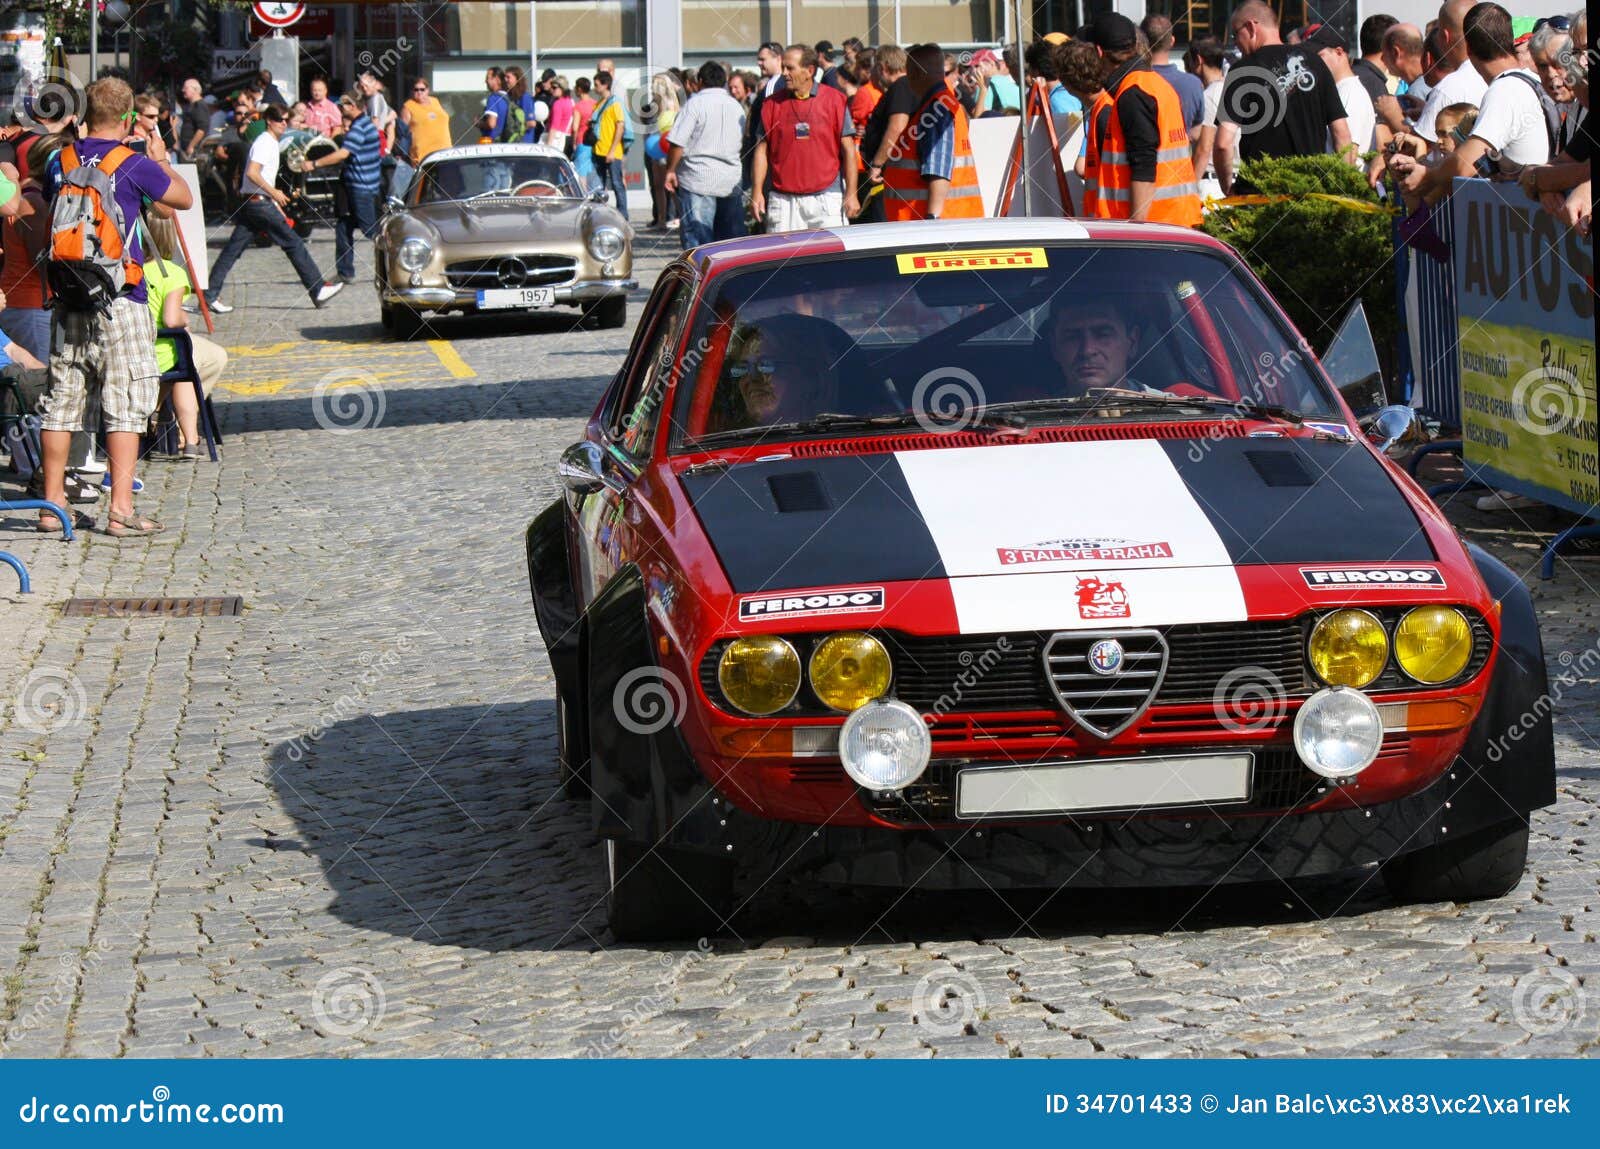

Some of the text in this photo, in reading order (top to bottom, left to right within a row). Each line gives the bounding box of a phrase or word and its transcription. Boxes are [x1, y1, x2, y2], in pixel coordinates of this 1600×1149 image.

[913, 252, 1033, 269] PIRELLI
[520, 289, 548, 304] 1957
[1021, 549, 1095, 562] RALLYE
[1101, 544, 1168, 559] PRAHA
[1311, 570, 1432, 583] FERODO
[749, 593, 874, 614] FERODO
